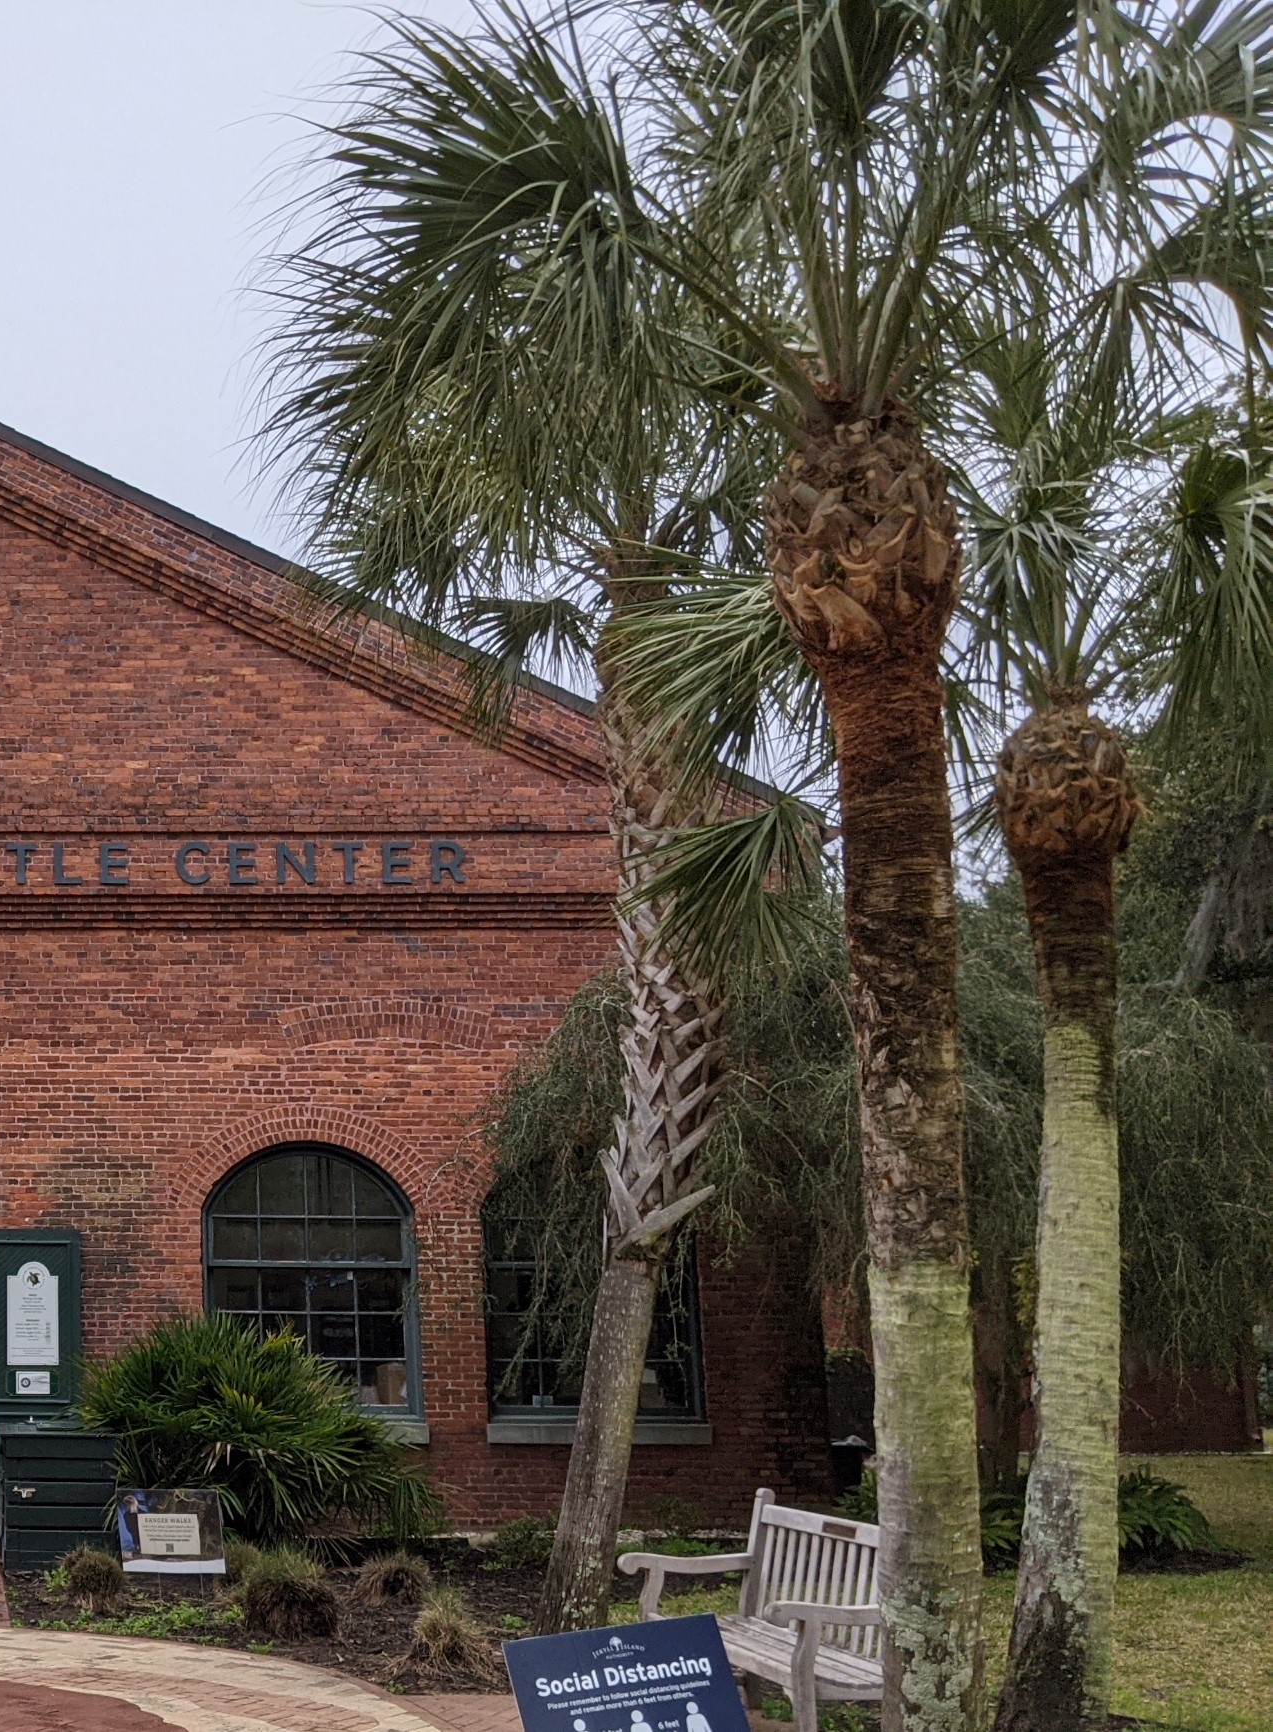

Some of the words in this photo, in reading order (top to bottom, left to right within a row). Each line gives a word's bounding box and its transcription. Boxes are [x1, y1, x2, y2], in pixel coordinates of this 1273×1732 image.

[176, 840, 465, 885] CENTER
[591, 1646, 614, 1660] JEKYLL
[535, 1669, 600, 1697] Social
[603, 1656, 711, 1686] Distancing
[547, 1702, 568, 1710] Please
[569, 1696, 602, 1706] remember
[602, 1694, 610, 1702] to
[610, 1692, 629, 1700] follow
[630, 1688, 647, 1697] social
[648, 1683, 679, 1694] distancing
[679, 1680, 710, 1690] guidelines
[569, 1708, 582, 1716] and
[583, 1704, 605, 1713] remain
[605, 1702, 622, 1710] more
[622, 1699, 637, 1707] than
[644, 1696, 657, 1704] feet
[657, 1694, 672, 1702] from
[672, 1691, 694, 1700] others.
[658, 1721, 664, 1730] 6
[664, 1719, 680, 1728] feet
